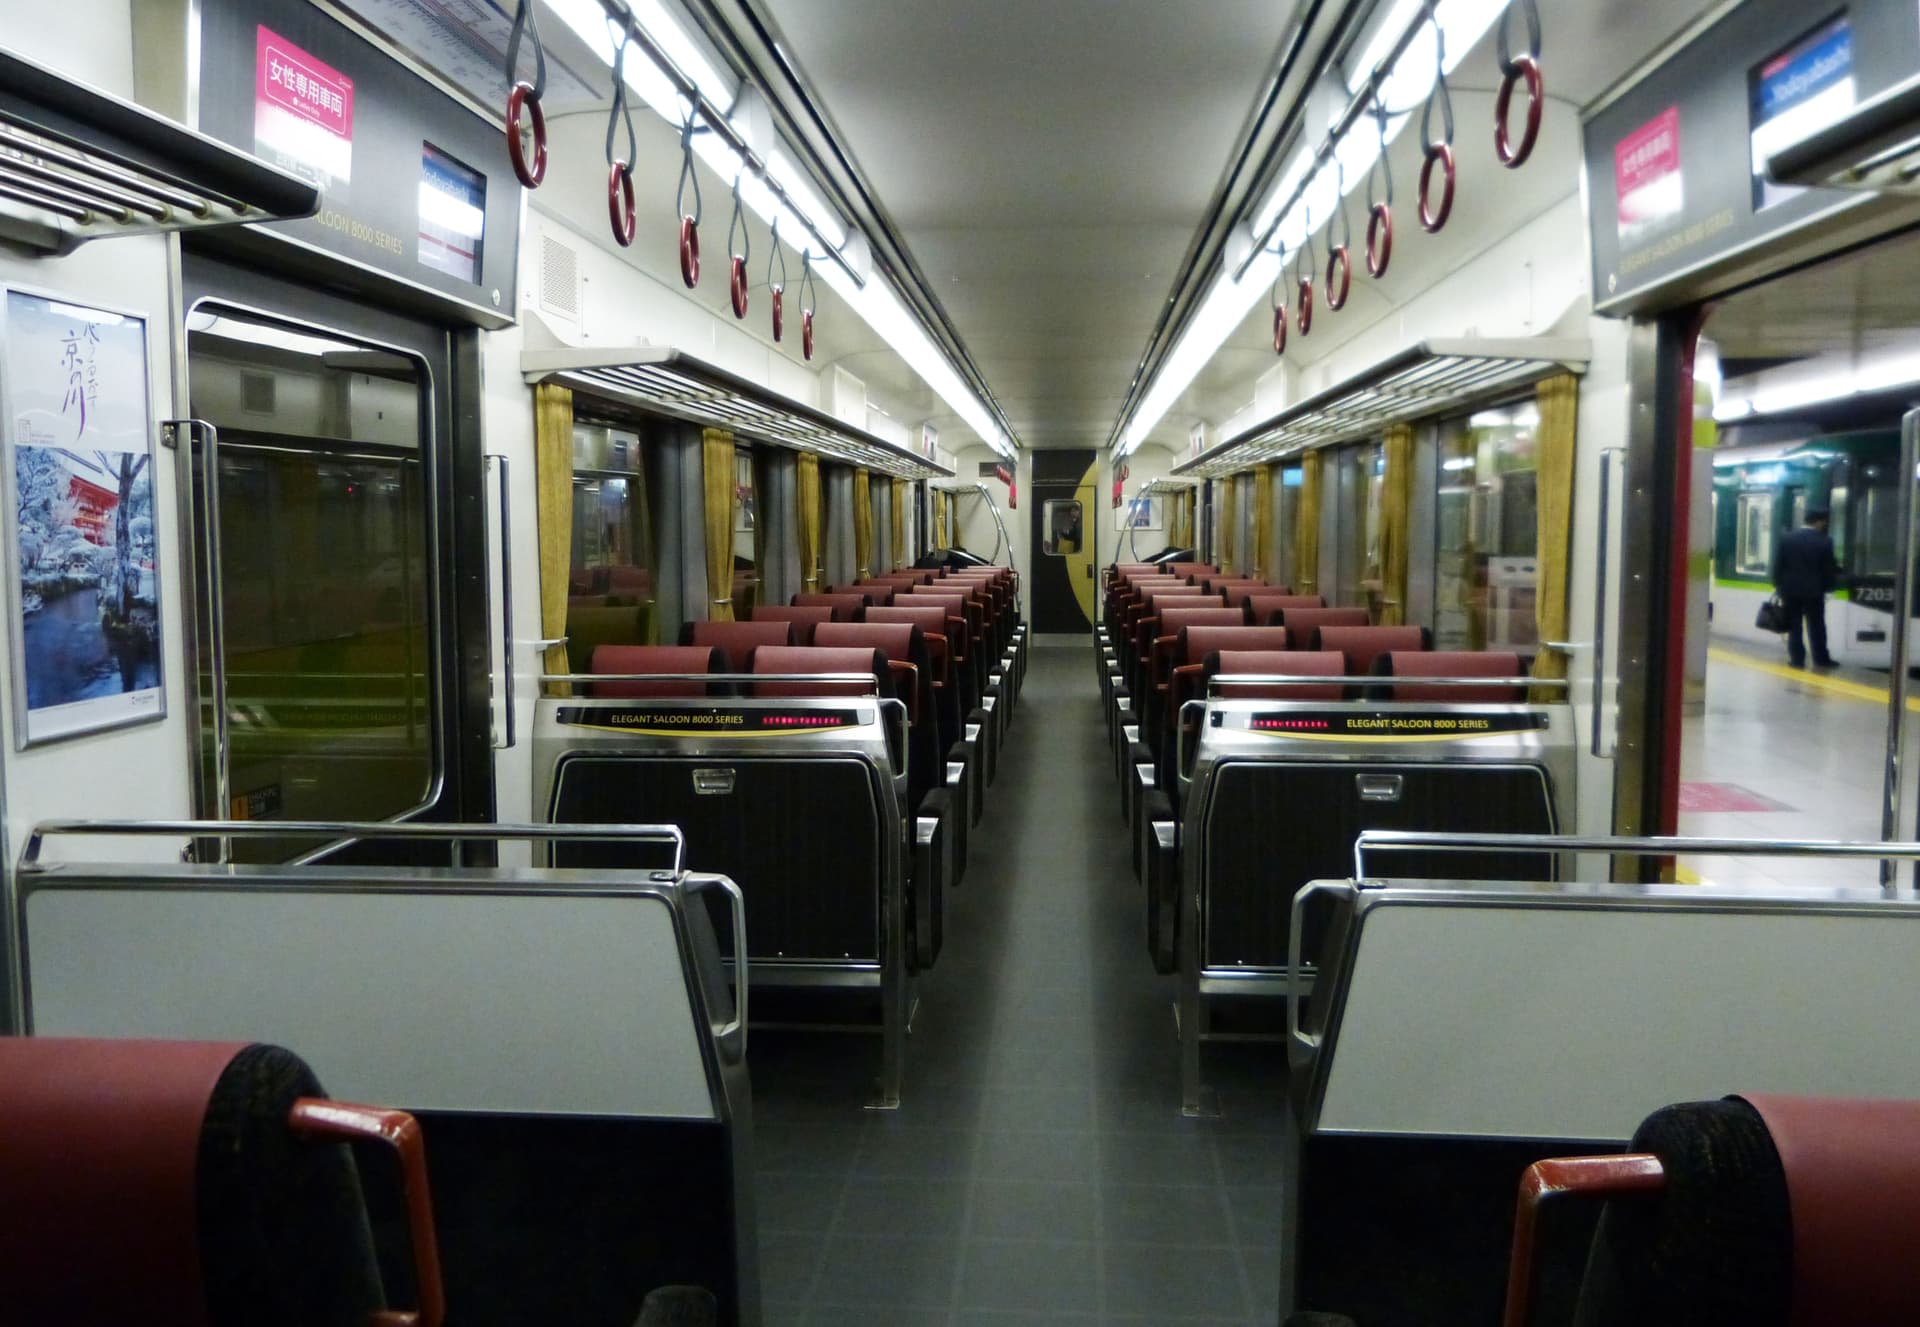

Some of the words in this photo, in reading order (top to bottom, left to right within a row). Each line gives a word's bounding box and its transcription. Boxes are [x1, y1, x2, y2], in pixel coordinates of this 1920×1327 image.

[270, 58, 343, 118] 女性専用車両
[313, 207, 350, 235] ALOON
[351, 220, 374, 243] 8000
[375, 231, 403, 255] SERIES
[1856, 588, 1894, 601] 7203
[611, 714, 652, 724] ELEGANT
[653, 714, 690, 724] SALOON
[692, 714, 713, 724] 8000
[715, 715, 744, 725] SERIES
[1346, 719, 1390, 728] ELEGANT
[1391, 719, 1432, 728] SALOON
[1433, 719, 1456, 729] 8000
[1457, 719, 1489, 729] SERIES
